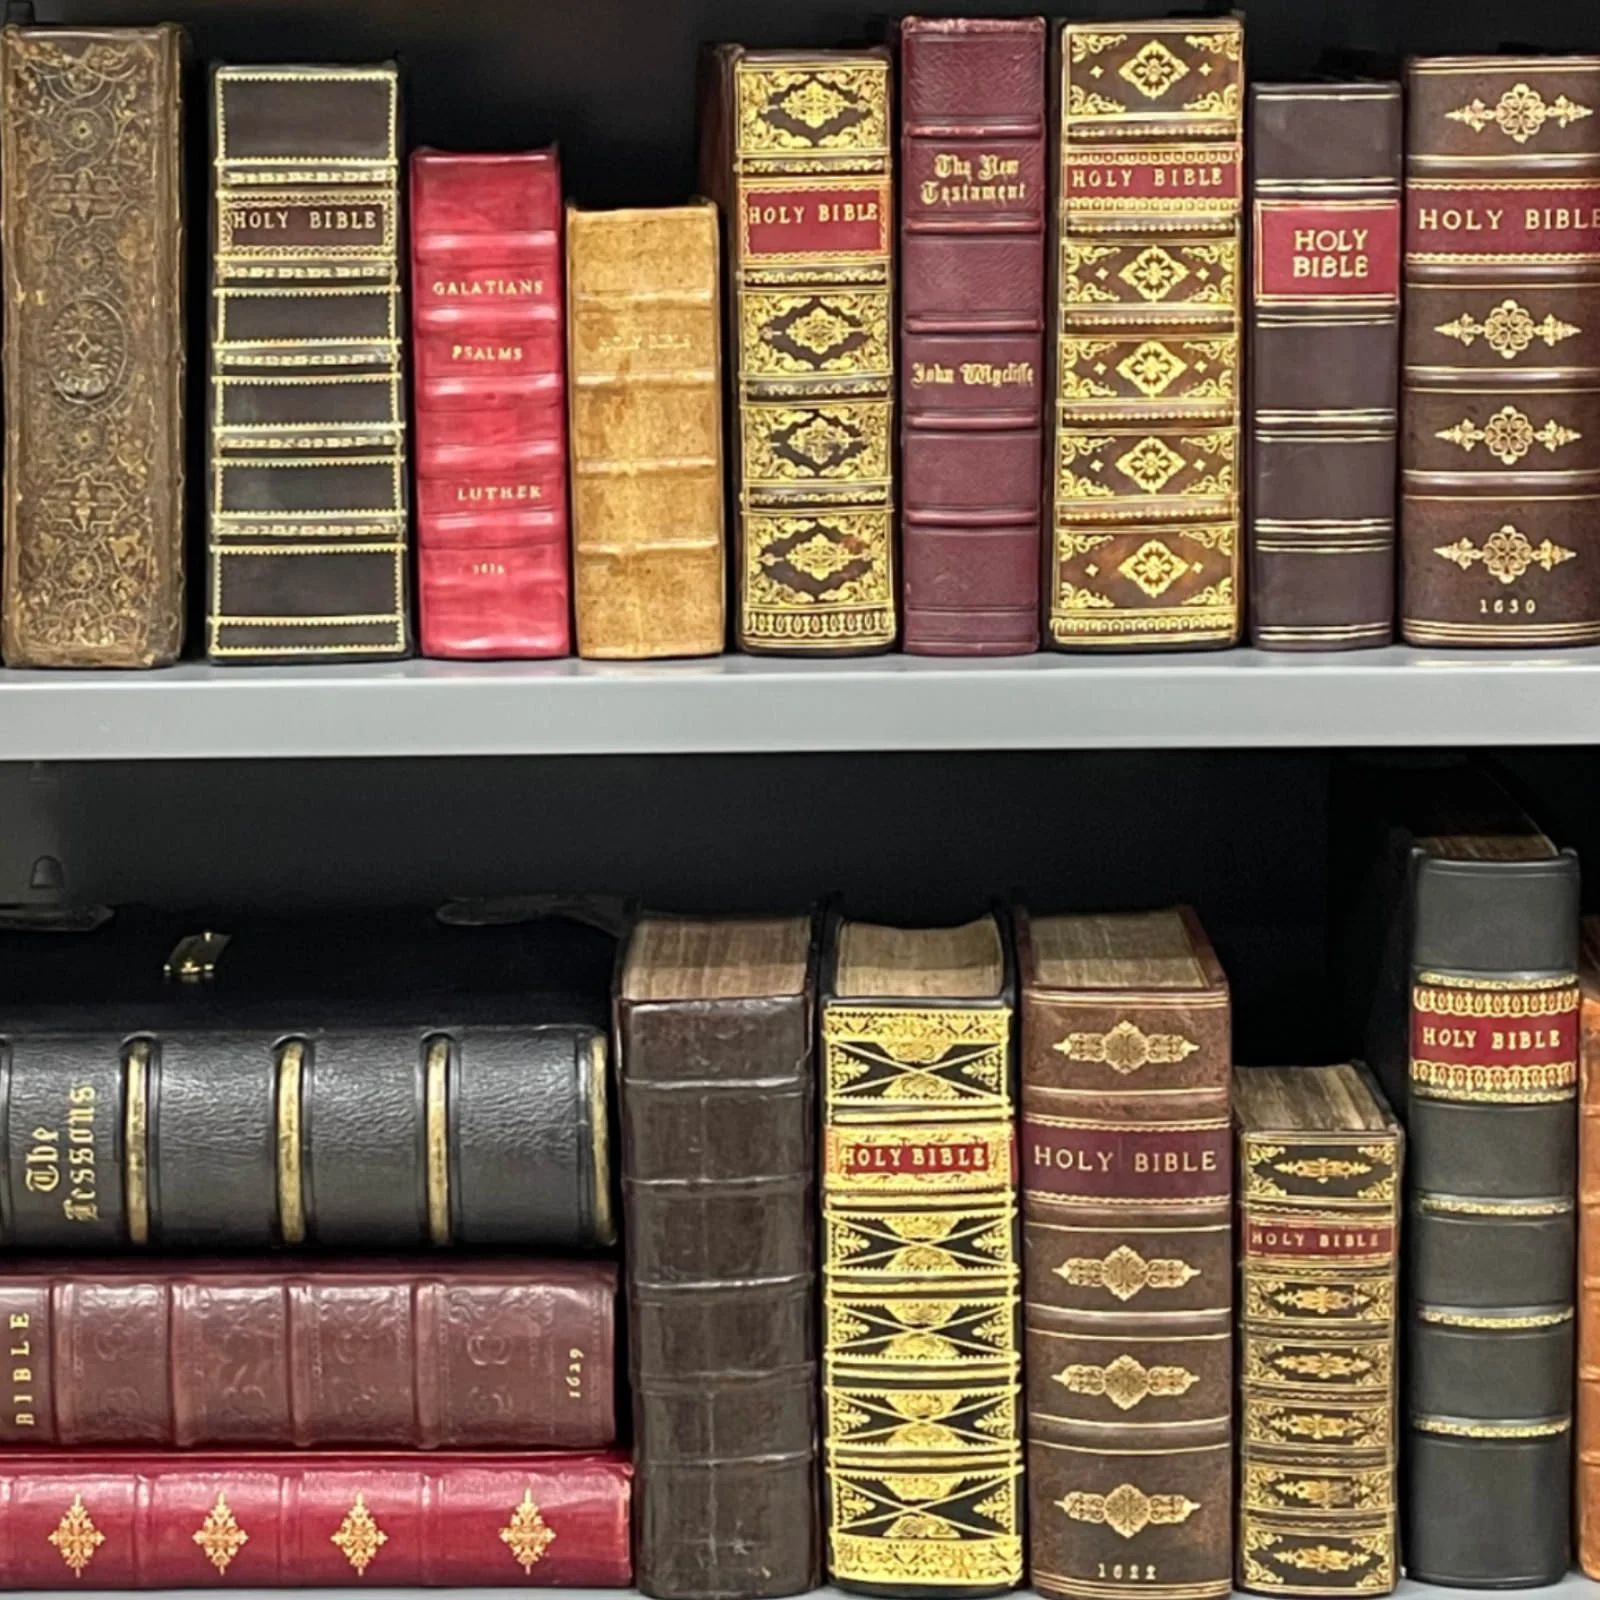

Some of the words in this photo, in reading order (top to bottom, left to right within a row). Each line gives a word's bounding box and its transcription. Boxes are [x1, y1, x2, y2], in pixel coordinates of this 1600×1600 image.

[1072, 169, 1133, 188] HOLY
[1153, 167, 1224, 187] BIBLE
[920, 180, 1027, 208] Testament
[233, 210, 290, 229] HOLY
[309, 210, 377, 229] BIBLE
[749, 205, 806, 225] HOLY
[818, 202, 878, 223] BIBLE
[1418, 208, 1504, 230] HOLY
[1294, 229, 1369, 252] HOLY
[1292, 255, 1369, 279] BIBLE
[432, 280, 545, 297] GALATIANS
[452, 345, 523, 361] PSALMS
[457, 484, 542, 501] LUTHER
[1479, 598, 1537, 614] 1630
[1423, 1027, 1477, 1049] HOLY
[1491, 1031, 1561, 1050] BIBLE
[25, 1127, 59, 1192] The
[64, 1085, 99, 1221] Lessons
[841, 1147, 901, 1167] HOLY
[911, 1147, 985, 1167] BIBLE
[1033, 1145, 1113, 1173] HOLY
[1134, 1150, 1218, 1173] BIBLE
[1251, 1231, 1305, 1247] HOLY
[1319, 1233, 1380, 1247] BIBLE
[9, 1312, 35, 1425] BIBLE
[565, 1347, 584, 1398] 1629
